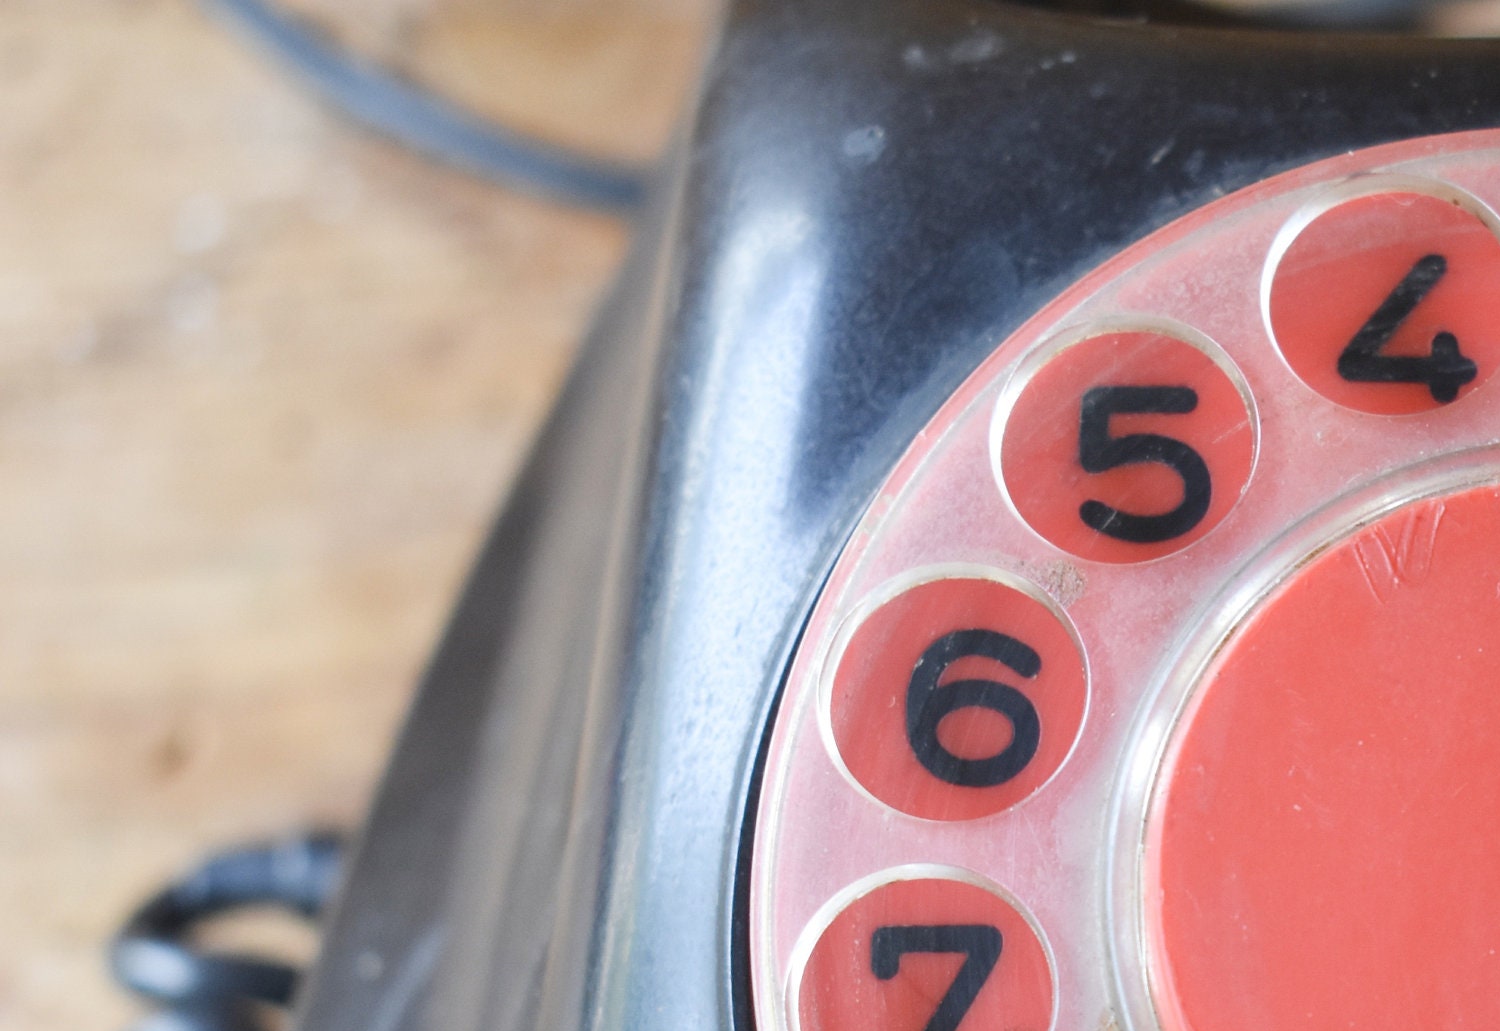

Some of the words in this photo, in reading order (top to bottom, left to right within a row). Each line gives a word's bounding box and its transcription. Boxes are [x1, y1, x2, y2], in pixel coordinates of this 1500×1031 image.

[1338, 254, 1477, 403] 4
[1079, 386, 1211, 543] 5
[906, 629, 1040, 787] 6
